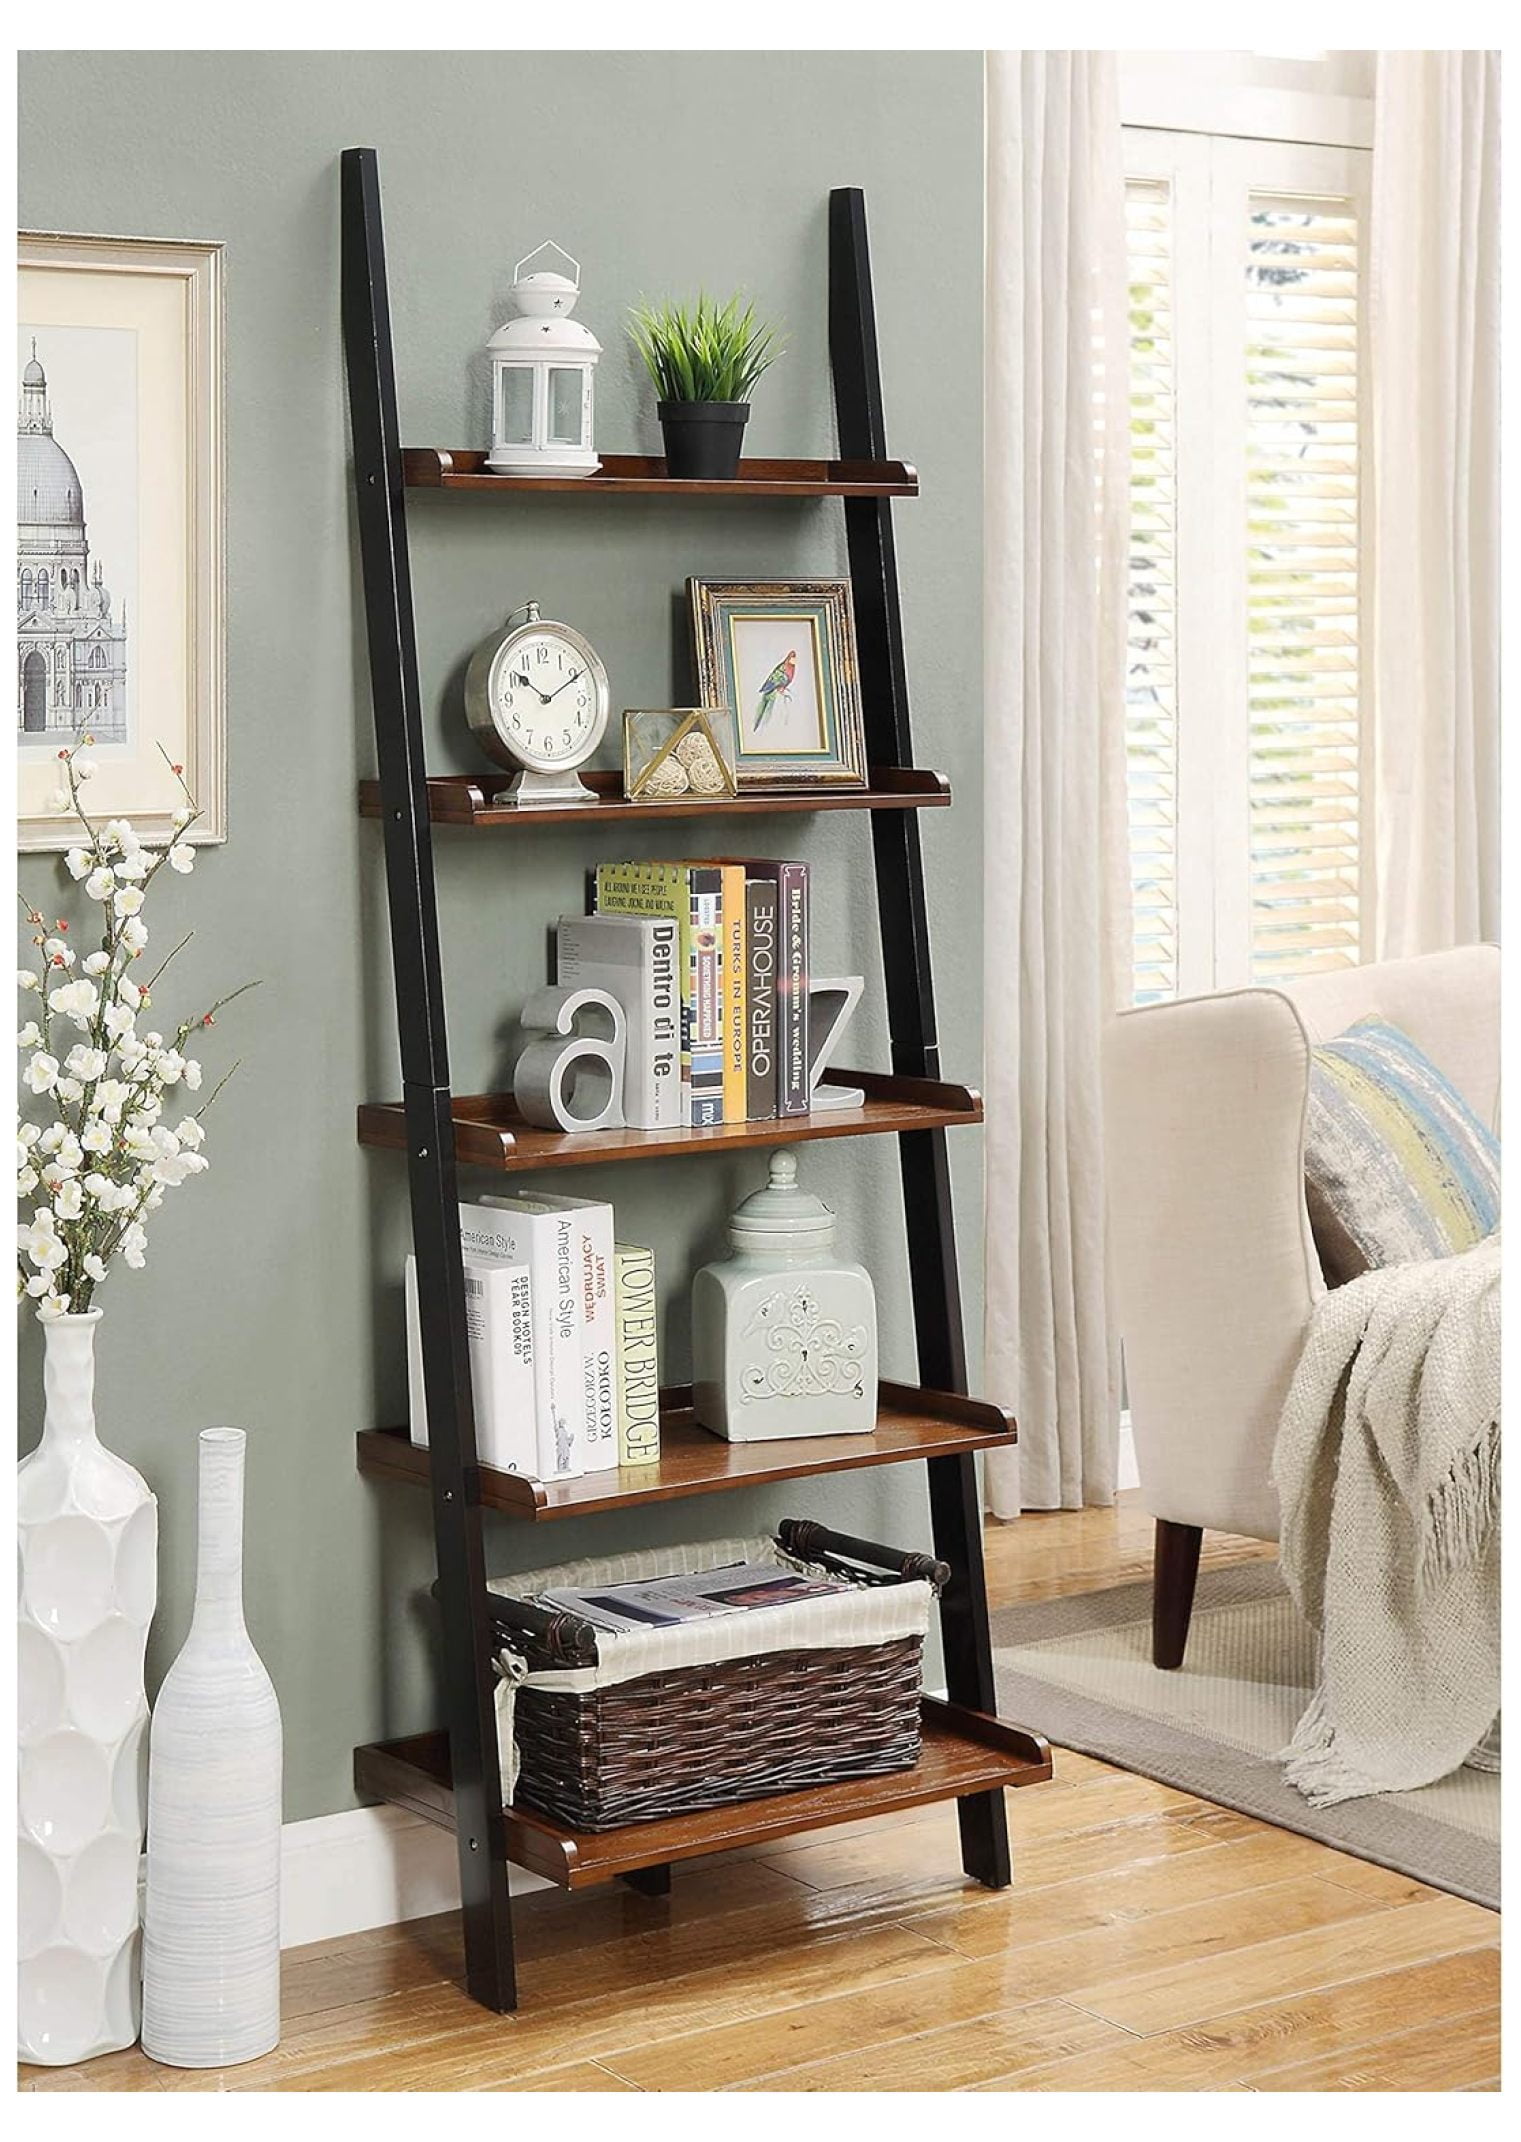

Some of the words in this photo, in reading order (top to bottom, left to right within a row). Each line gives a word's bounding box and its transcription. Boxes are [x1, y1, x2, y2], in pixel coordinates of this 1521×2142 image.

[521, 654, 530, 672] 11
[537, 647, 550, 664] 12
[557, 654, 563, 671] 1
[568, 667, 578, 684] 2
[504, 692, 514, 708] 9
[511, 712, 521, 730] 8
[574, 710, 585, 728] 4
[525, 728, 534, 745] 7
[543, 735, 553, 752] 6
[562, 728, 572, 746] 5
[791, 887, 802, 933] Bride
[732, 919, 742, 973] TURKS
[791, 934, 802, 950] &
[652, 926, 674, 1008] Dentro
[732, 980, 742, 999] IN
[751, 906, 774, 1077] OPERAHOUSE
[653, 1018, 674, 1040] di
[733, 1006, 742, 1073] EUROPE
[653, 1052, 674, 1078] te
[790, 1027, 802, 1091] wedding
[496, 1233, 517, 1252] Style
[556, 1219, 572, 1294] American
[595, 1255, 607, 1298] ŚWIAT
[511, 1277, 521, 1308] YEAR
[520, 1276, 530, 1317] DESIGN
[621, 1255, 656, 1352] TOWER
[554, 1300, 575, 1339] Style
[521, 1321, 533, 1365] HOTELS
[624, 1358, 659, 1460] BRIDGE
